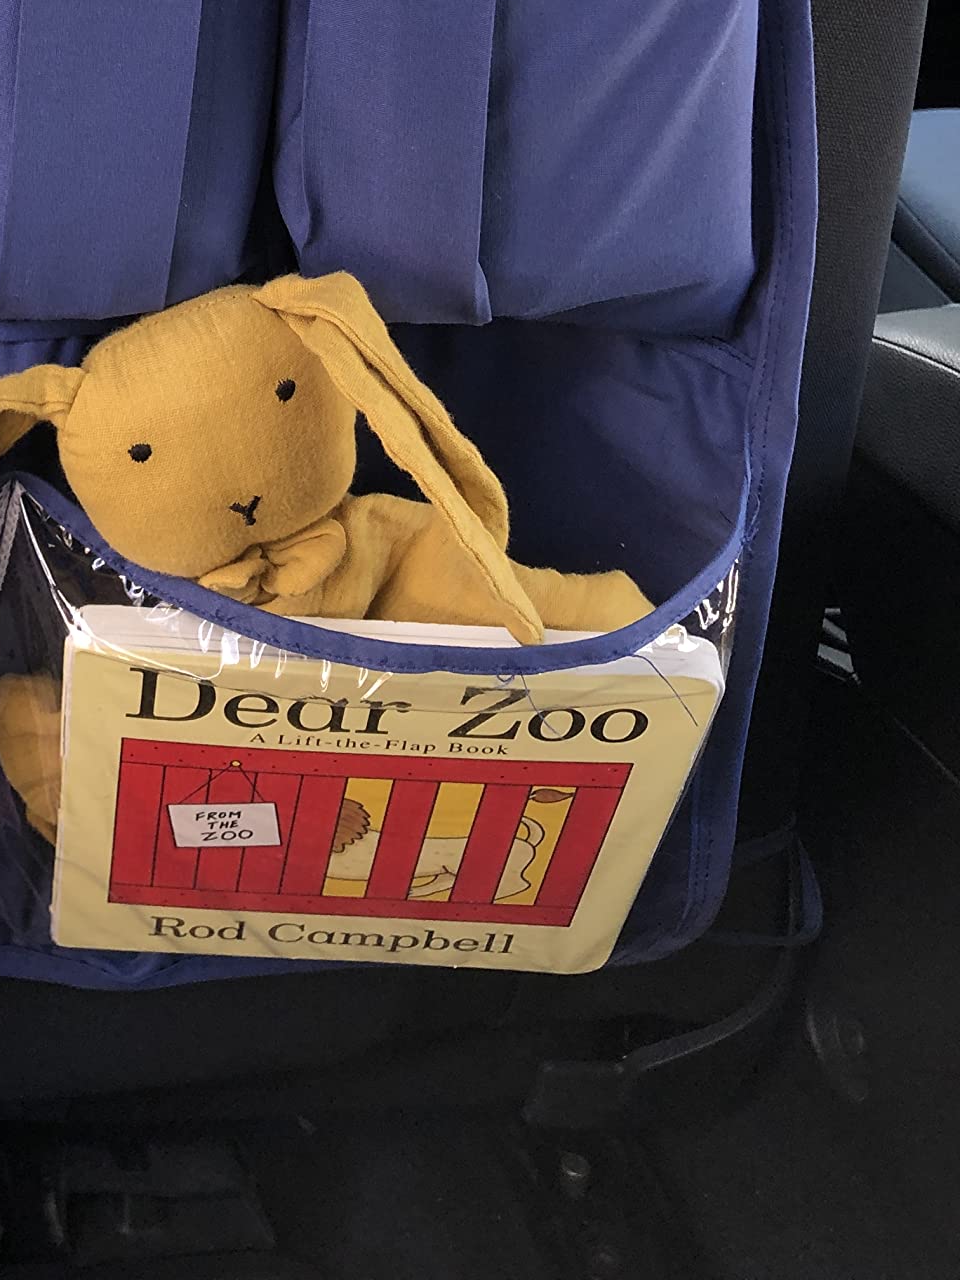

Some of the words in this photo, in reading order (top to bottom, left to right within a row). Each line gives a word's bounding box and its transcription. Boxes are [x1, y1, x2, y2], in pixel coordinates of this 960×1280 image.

[125, 667, 412, 736] Dear
[447, 686, 649, 744] Zoo
[249, 733, 266, 744] A
[278, 734, 437, 754] Lift-the-Flap
[448, 742, 509, 756] Book
[195, 810, 242, 821] FROM
[208, 820, 239, 830] THE
[201, 829, 254, 842] ZOO
[148, 916, 247, 941] Rod
[268, 922, 515, 955] Campbell
